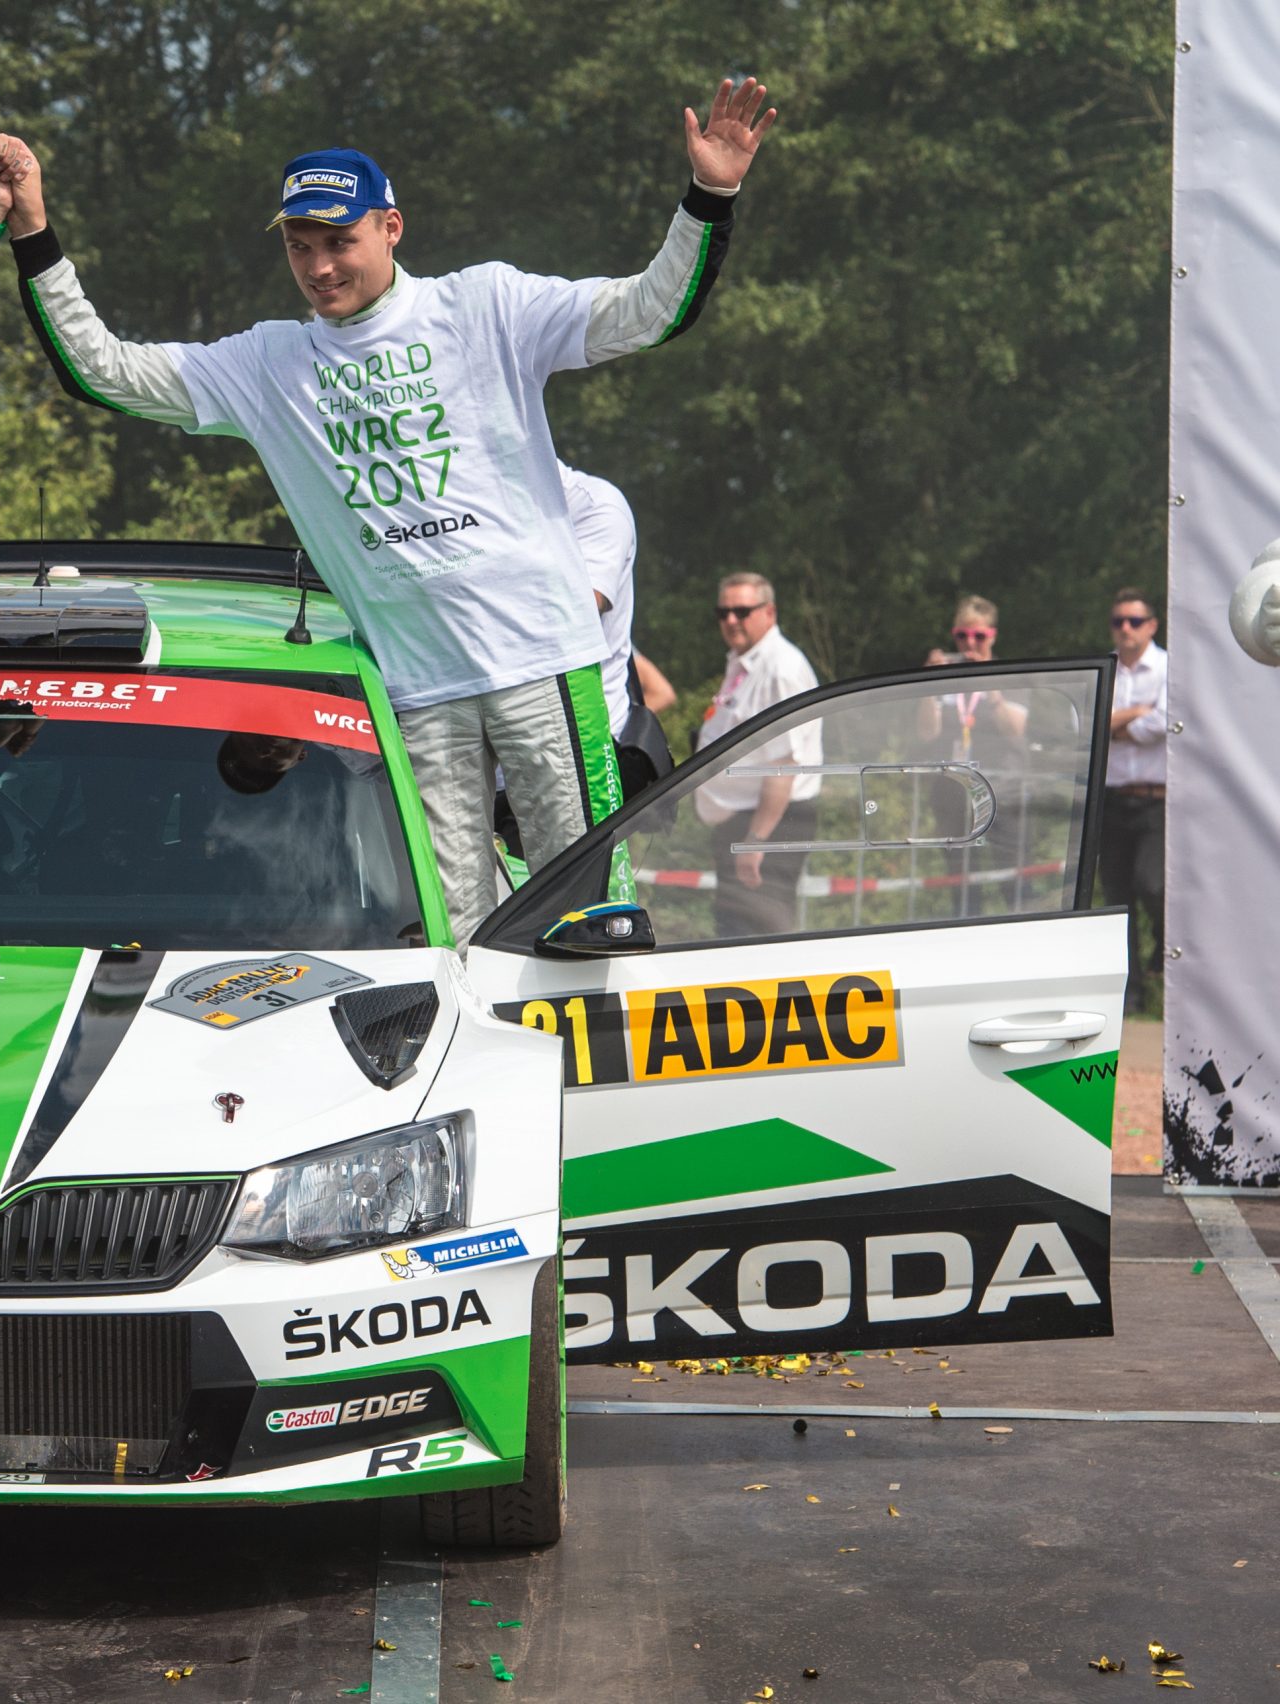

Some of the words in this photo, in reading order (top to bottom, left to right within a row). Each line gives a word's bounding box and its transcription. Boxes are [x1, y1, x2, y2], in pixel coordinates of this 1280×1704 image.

[301, 173, 354, 187] MICHELIN
[313, 342, 432, 391] WORLD
[316, 377, 438, 415] CHAMPIONS
[323, 403, 451, 456] WRC2
[384, 513, 479, 544] ŠKODA
[51, 699, 131, 711] motorsport
[314, 710, 372, 734] WRC
[184, 982, 234, 1003] ADAC
[225, 962, 293, 988] RALLYE
[206, 974, 293, 1006] DEUTSCHLAND
[252, 990, 299, 1007] 31
[645, 974, 886, 1075] ADAC
[432, 1234, 520, 1263] MICHELIN
[282, 1289, 491, 1361] ŠKODA
[285, 1406, 335, 1431] Castrol
[339, 1387, 433, 1425] EDGE
[366, 1433, 469, 1479] R5
